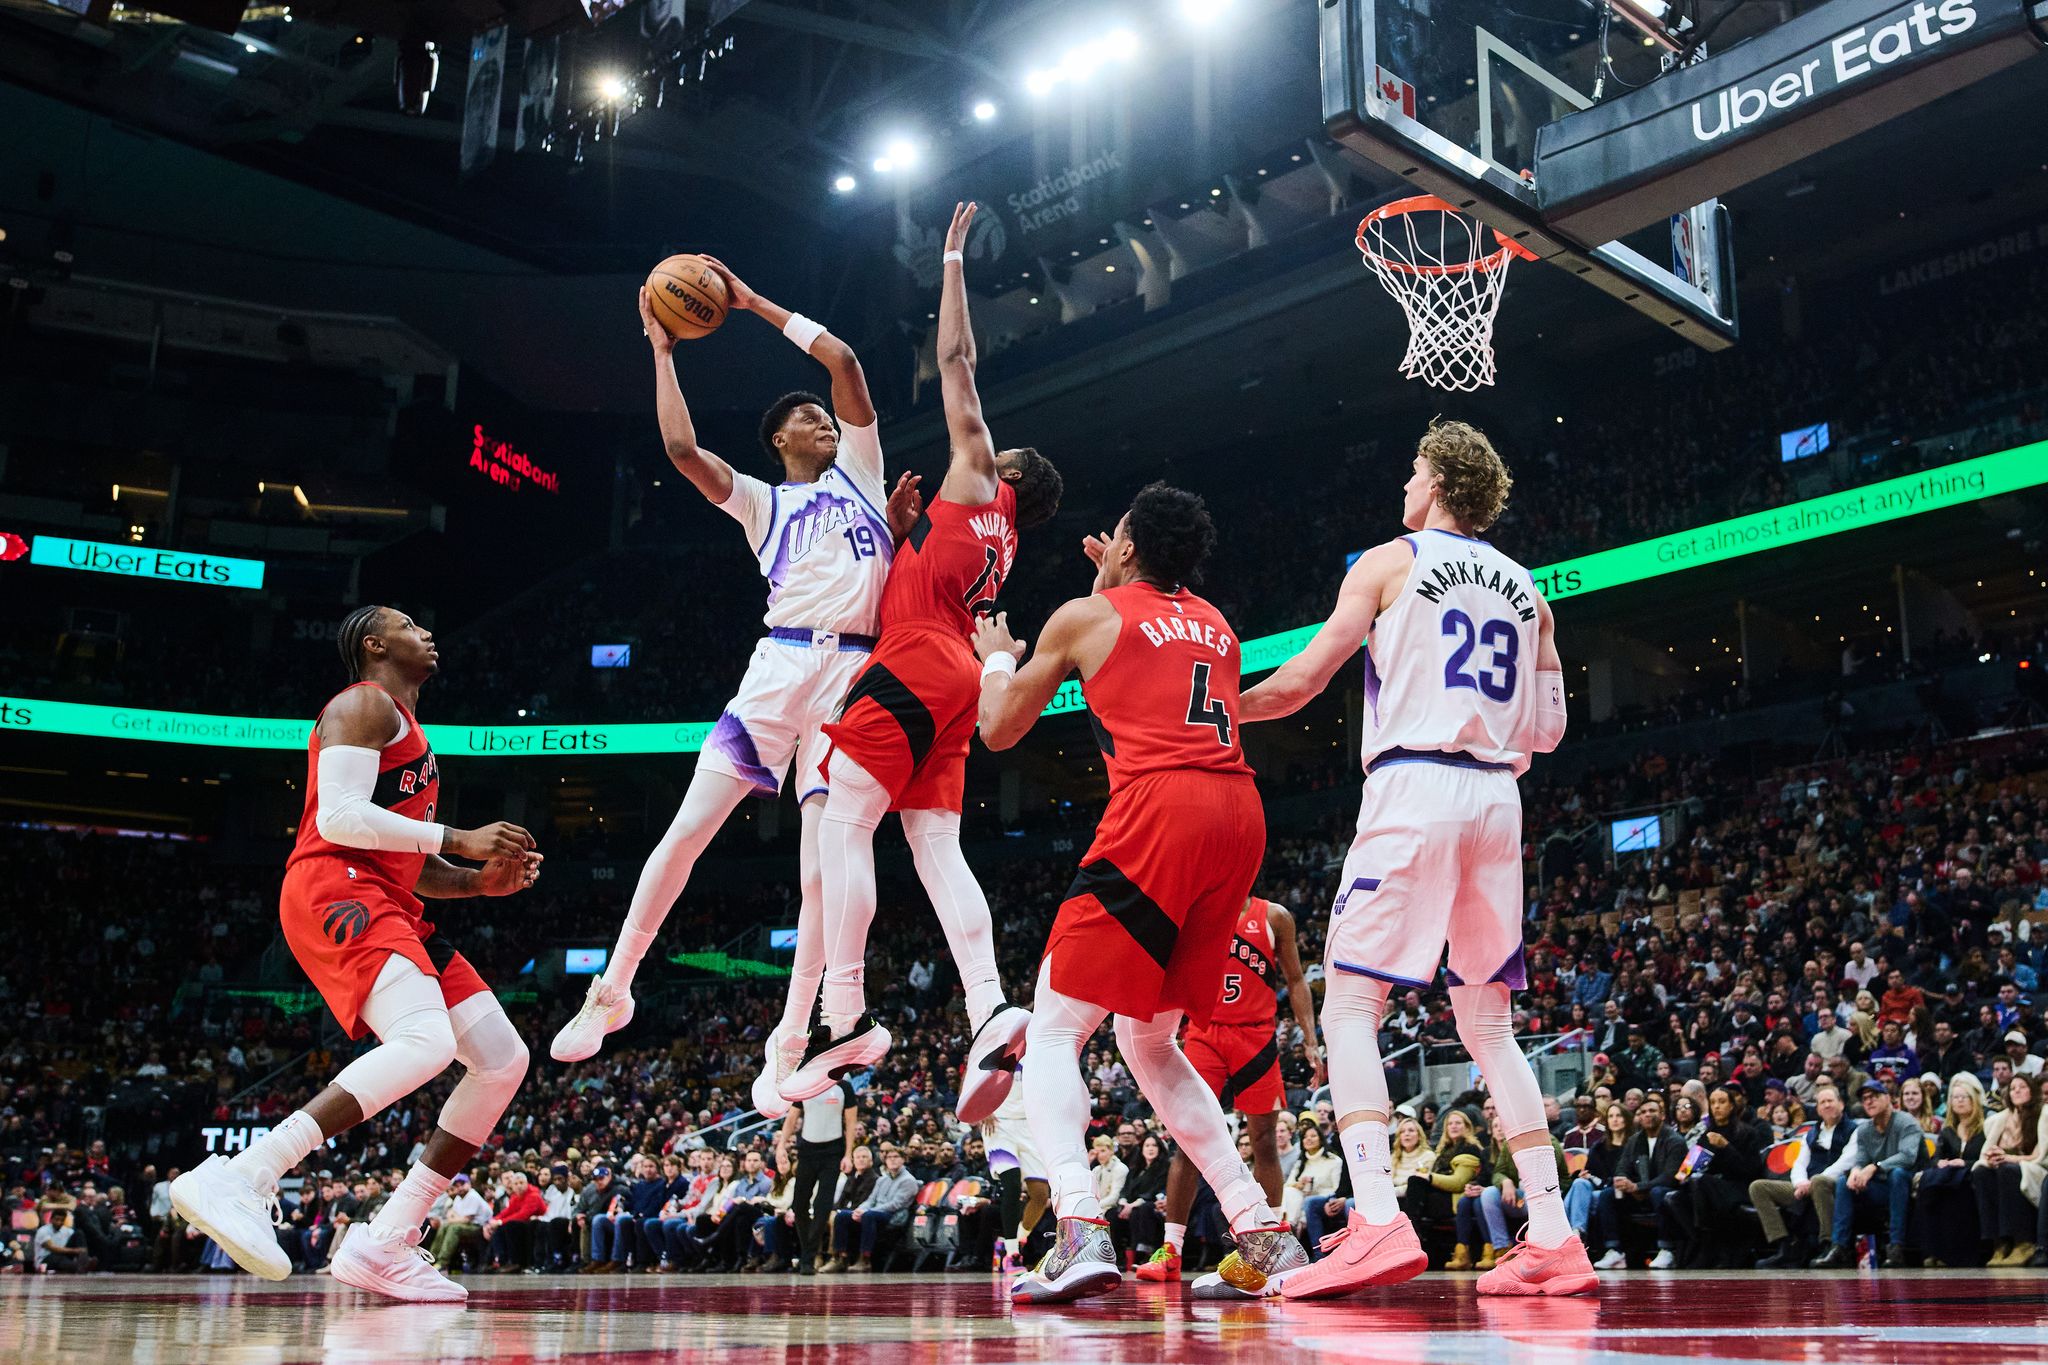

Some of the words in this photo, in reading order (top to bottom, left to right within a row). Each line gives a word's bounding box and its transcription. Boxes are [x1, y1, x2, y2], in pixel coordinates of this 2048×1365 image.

[1691, 58, 1821, 141] Uber
[1831, 0, 1978, 84] Eats
[1006, 150, 1122, 214] Scotiabank
[1020, 196, 1080, 235] Arena
[665, 281, 714, 323] Wilson
[788, 500, 865, 563] UTAH
[1656, 539, 1698, 564] Get
[1704, 517, 1781, 553] almost
[1787, 494, 1866, 530] almost
[1873, 468, 1986, 511] anything
[67, 543, 147, 573] Uber
[154, 552, 230, 583] Eats
[843, 525, 876, 561] 19
[1416, 561, 1536, 623] MARKKANEN
[1139, 616, 1232, 657] BARNES
[1441, 608, 1519, 704] 23
[1185, 661, 1233, 747] 4
[111, 712, 152, 731] Get
[157, 718, 230, 738] almost
[235, 724, 305, 742] almost
[468, 729, 534, 752] Uber
[542, 728, 608, 750] Eats
[1222, 973, 1242, 1003] 5
